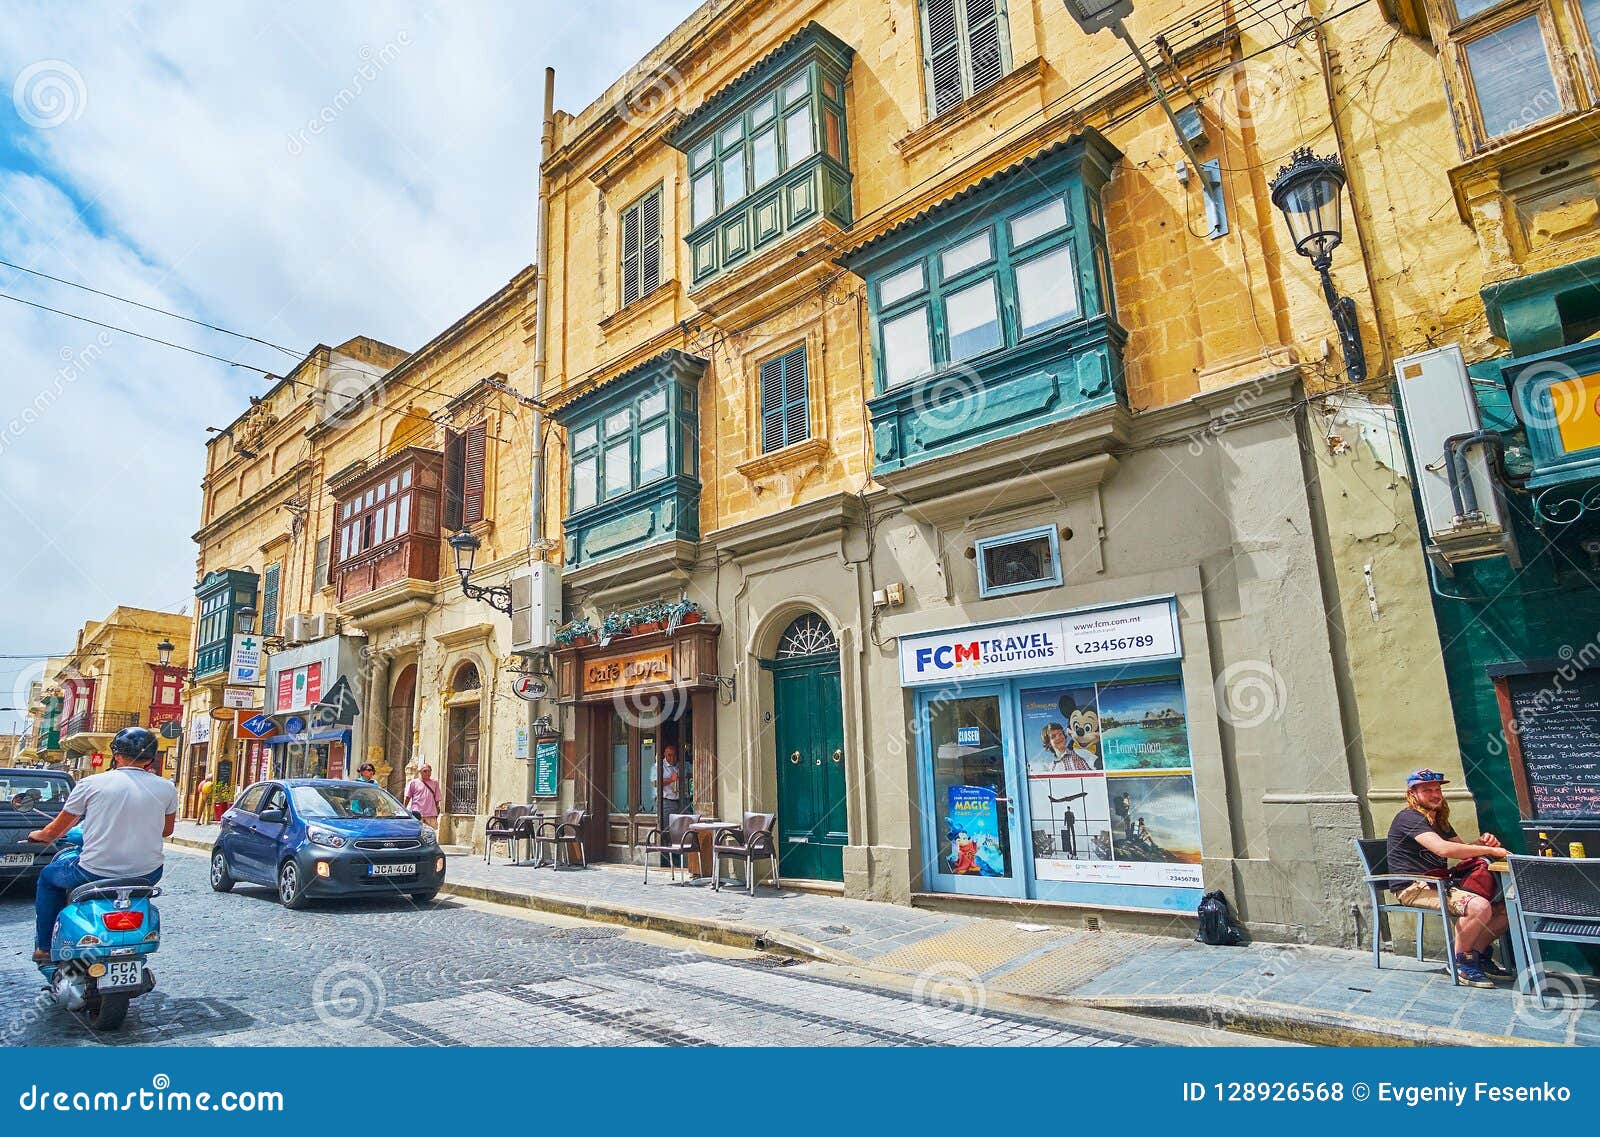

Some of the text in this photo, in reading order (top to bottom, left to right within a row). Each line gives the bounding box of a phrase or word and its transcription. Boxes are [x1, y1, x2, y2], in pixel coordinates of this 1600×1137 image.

[1073, 616, 1141, 631] www.fcm.com.mt
[1084, 634, 1154, 654] 23456789
[916, 632, 1053, 672] FCM TRAVEL
[982, 646, 1055, 664] SOLUTIONS
[589, 654, 669, 683] Café Royal
[959, 730, 980, 742] CLOSED
[1108, 739, 1161, 757] Honeymoon
[1531, 785, 1548, 794] TRY
[954, 800, 990, 810] MAGIC
[374, 863, 414, 874] JCA 406
[111, 961, 138, 975] FCA
[111, 973, 137, 985] 936
